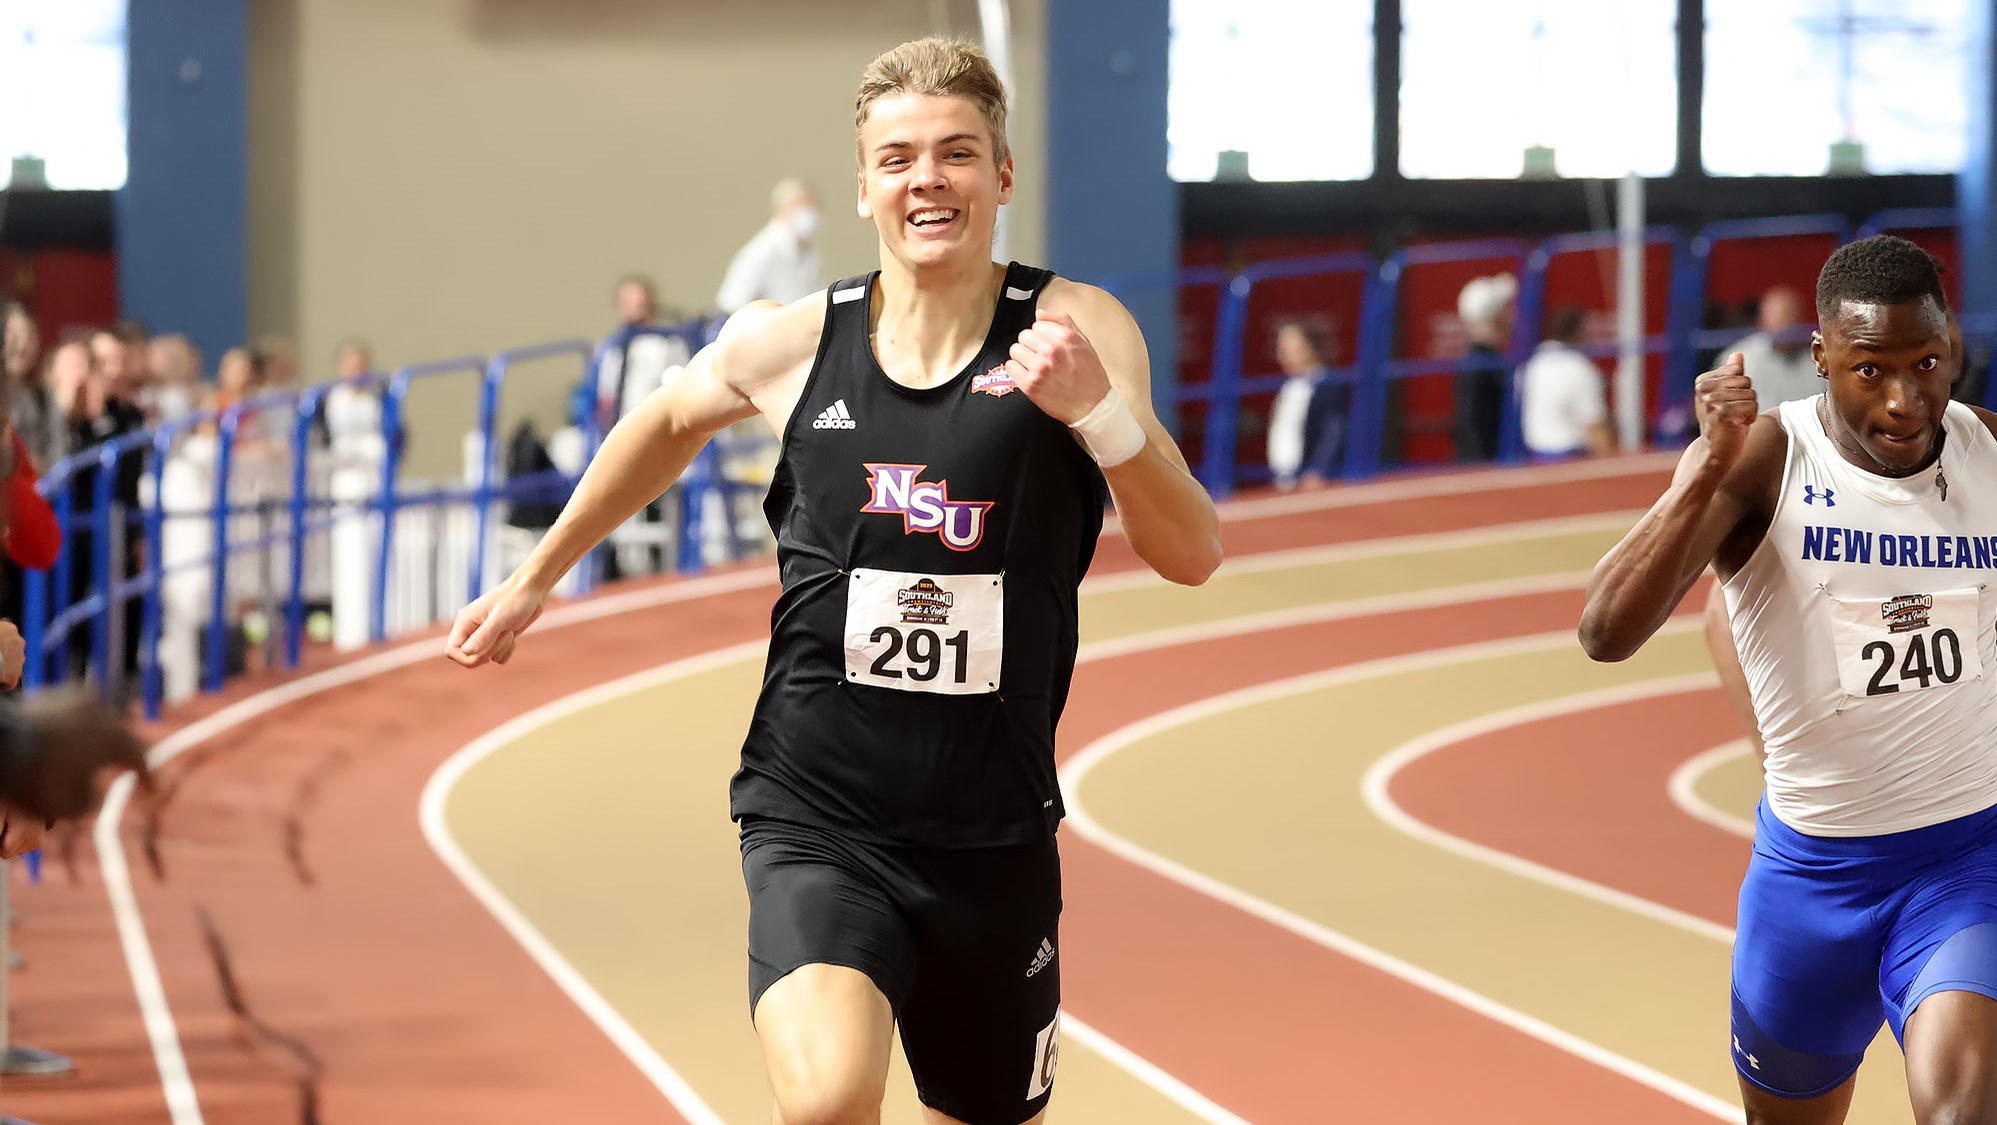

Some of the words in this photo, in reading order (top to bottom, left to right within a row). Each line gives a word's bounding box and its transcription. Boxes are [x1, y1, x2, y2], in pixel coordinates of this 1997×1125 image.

[812, 418, 856, 430] adidas
[870, 466, 986, 548] NSU
[1801, 525, 1873, 565] NEW
[898, 590, 952, 607] SOUTHLAND
[1882, 595, 1931, 616] SOUTHLAND
[869, 626, 969, 684] 291
[1861, 628, 1962, 696] 240
[1026, 947, 1055, 978] adidas
